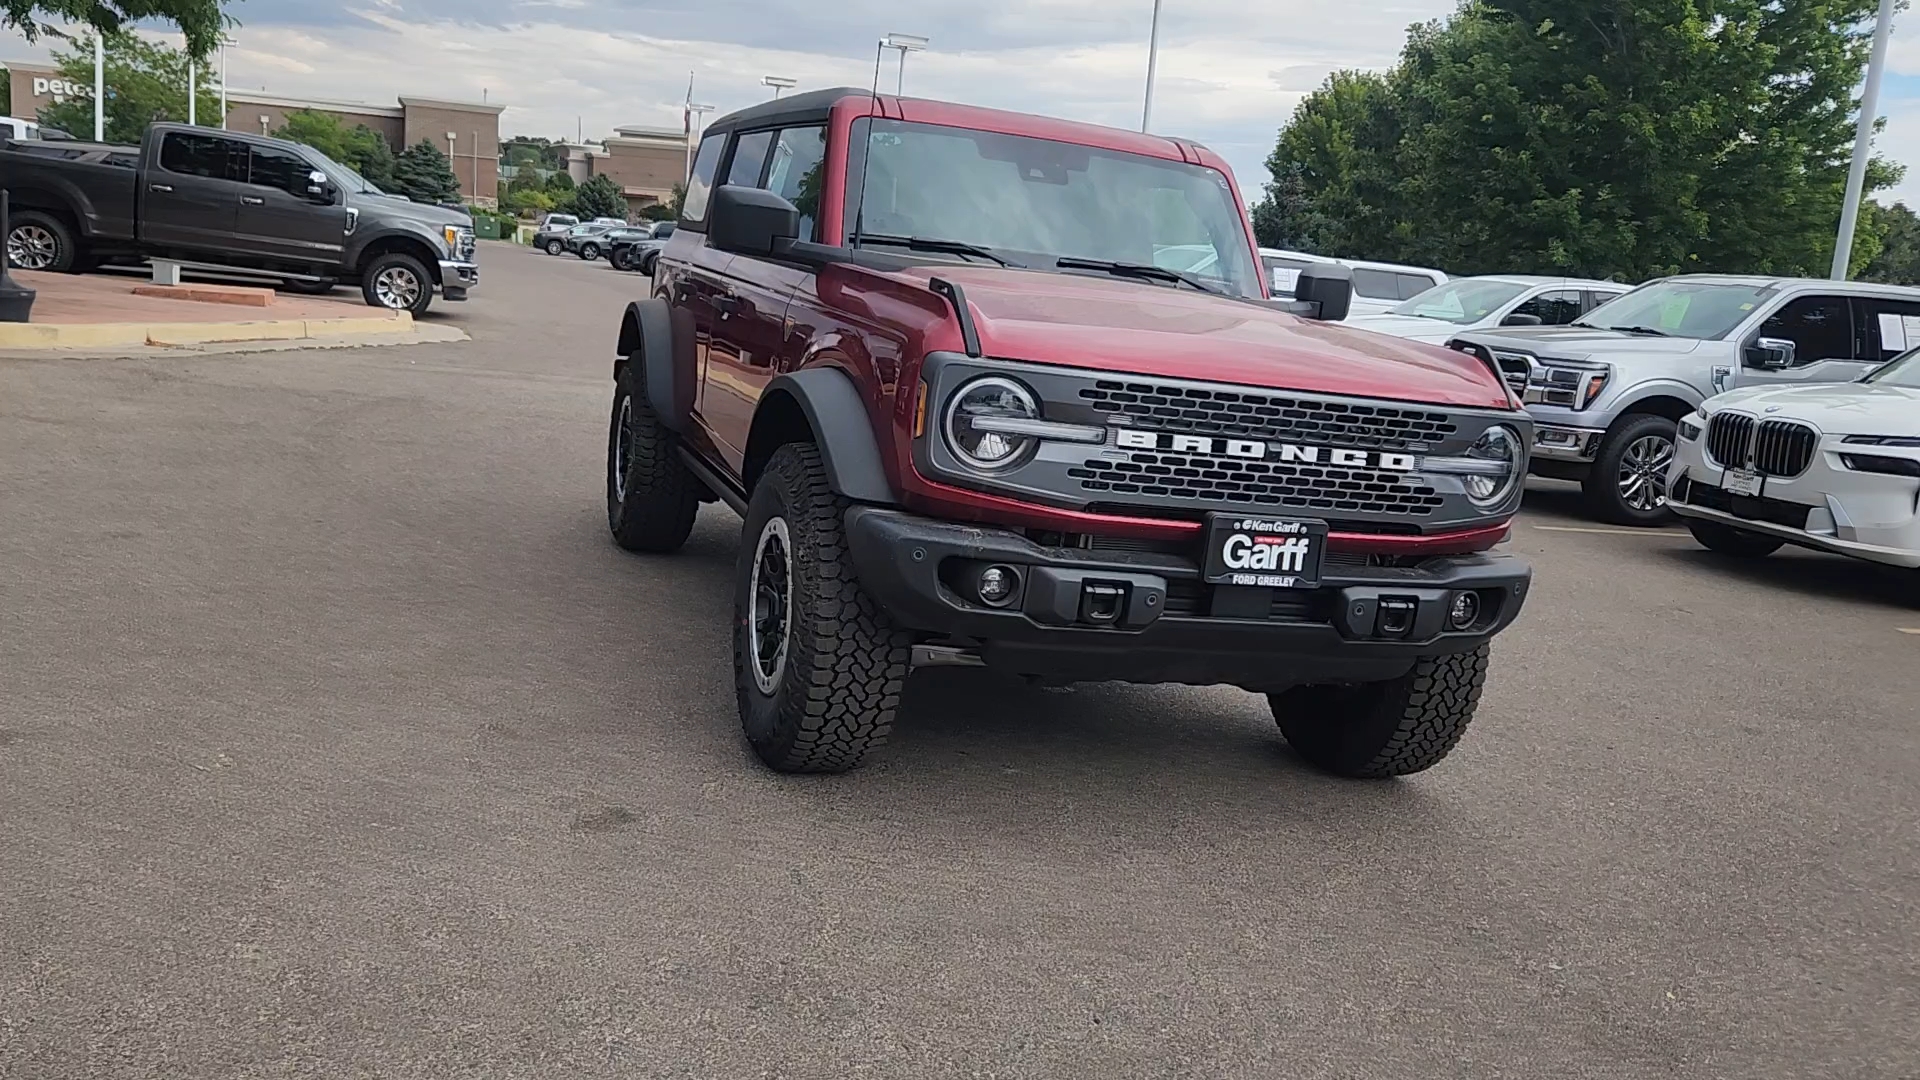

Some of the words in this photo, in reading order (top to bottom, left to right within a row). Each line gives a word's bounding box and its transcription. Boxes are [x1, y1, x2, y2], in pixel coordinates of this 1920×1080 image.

[1116, 429, 1416, 471] BRONCO
[1251, 520, 1273, 532] Ken
[1273, 521, 1300, 533] Garff
[1222, 533, 1309, 571] Garff
[1232, 574, 1256, 585] FORD
[1257, 576, 1295, 587] GREELEY
